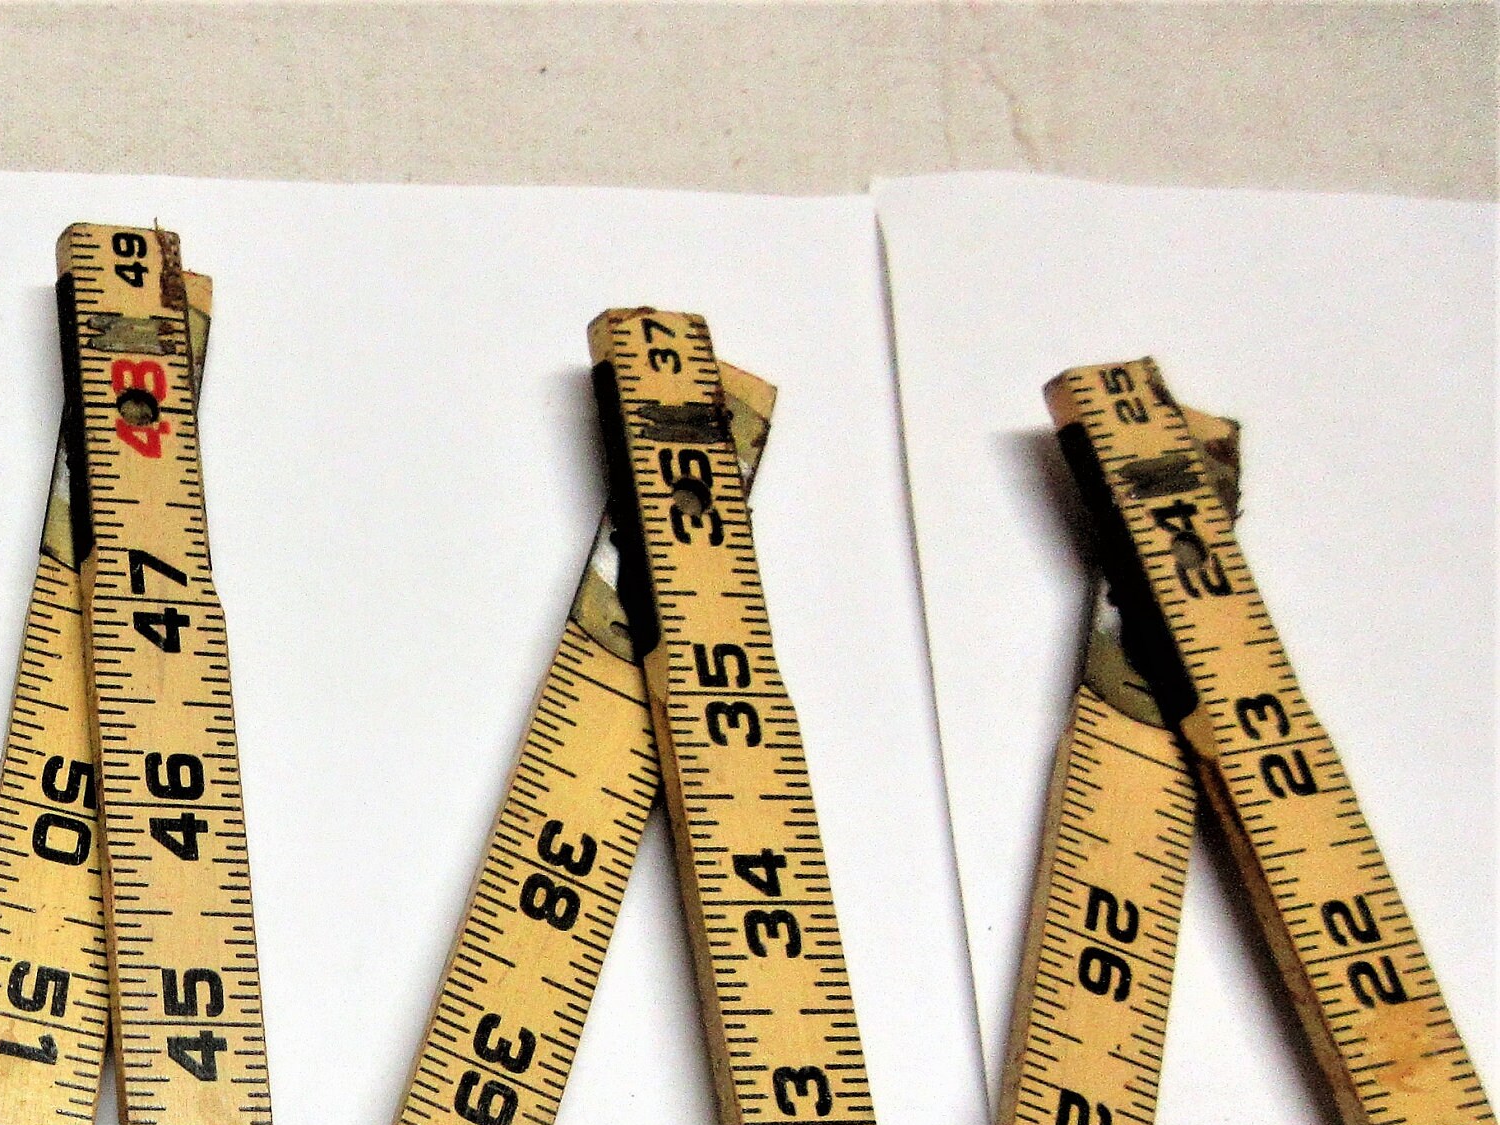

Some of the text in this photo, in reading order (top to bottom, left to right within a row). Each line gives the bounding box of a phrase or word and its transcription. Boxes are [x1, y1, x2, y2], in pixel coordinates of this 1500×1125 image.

[111, 232, 148, 287] 49
[642, 318, 682, 375] 37
[1100, 366, 1151, 427] 25
[111, 359, 170, 460] 48
[659, 447, 723, 547] 36
[1151, 498, 1232, 600] 24
[127, 548, 191, 654] 47
[695, 642, 762, 748] 35
[1234, 692, 1318, 799] 23
[31, 755, 96, 867] 50
[145, 751, 209, 861] 46
[518, 819, 597, 933] 38
[732, 847, 802, 959] 34
[1077, 884, 1140, 1003] 26
[1321, 894, 1410, 1010] 22
[161, 966, 234, 1082] 45
